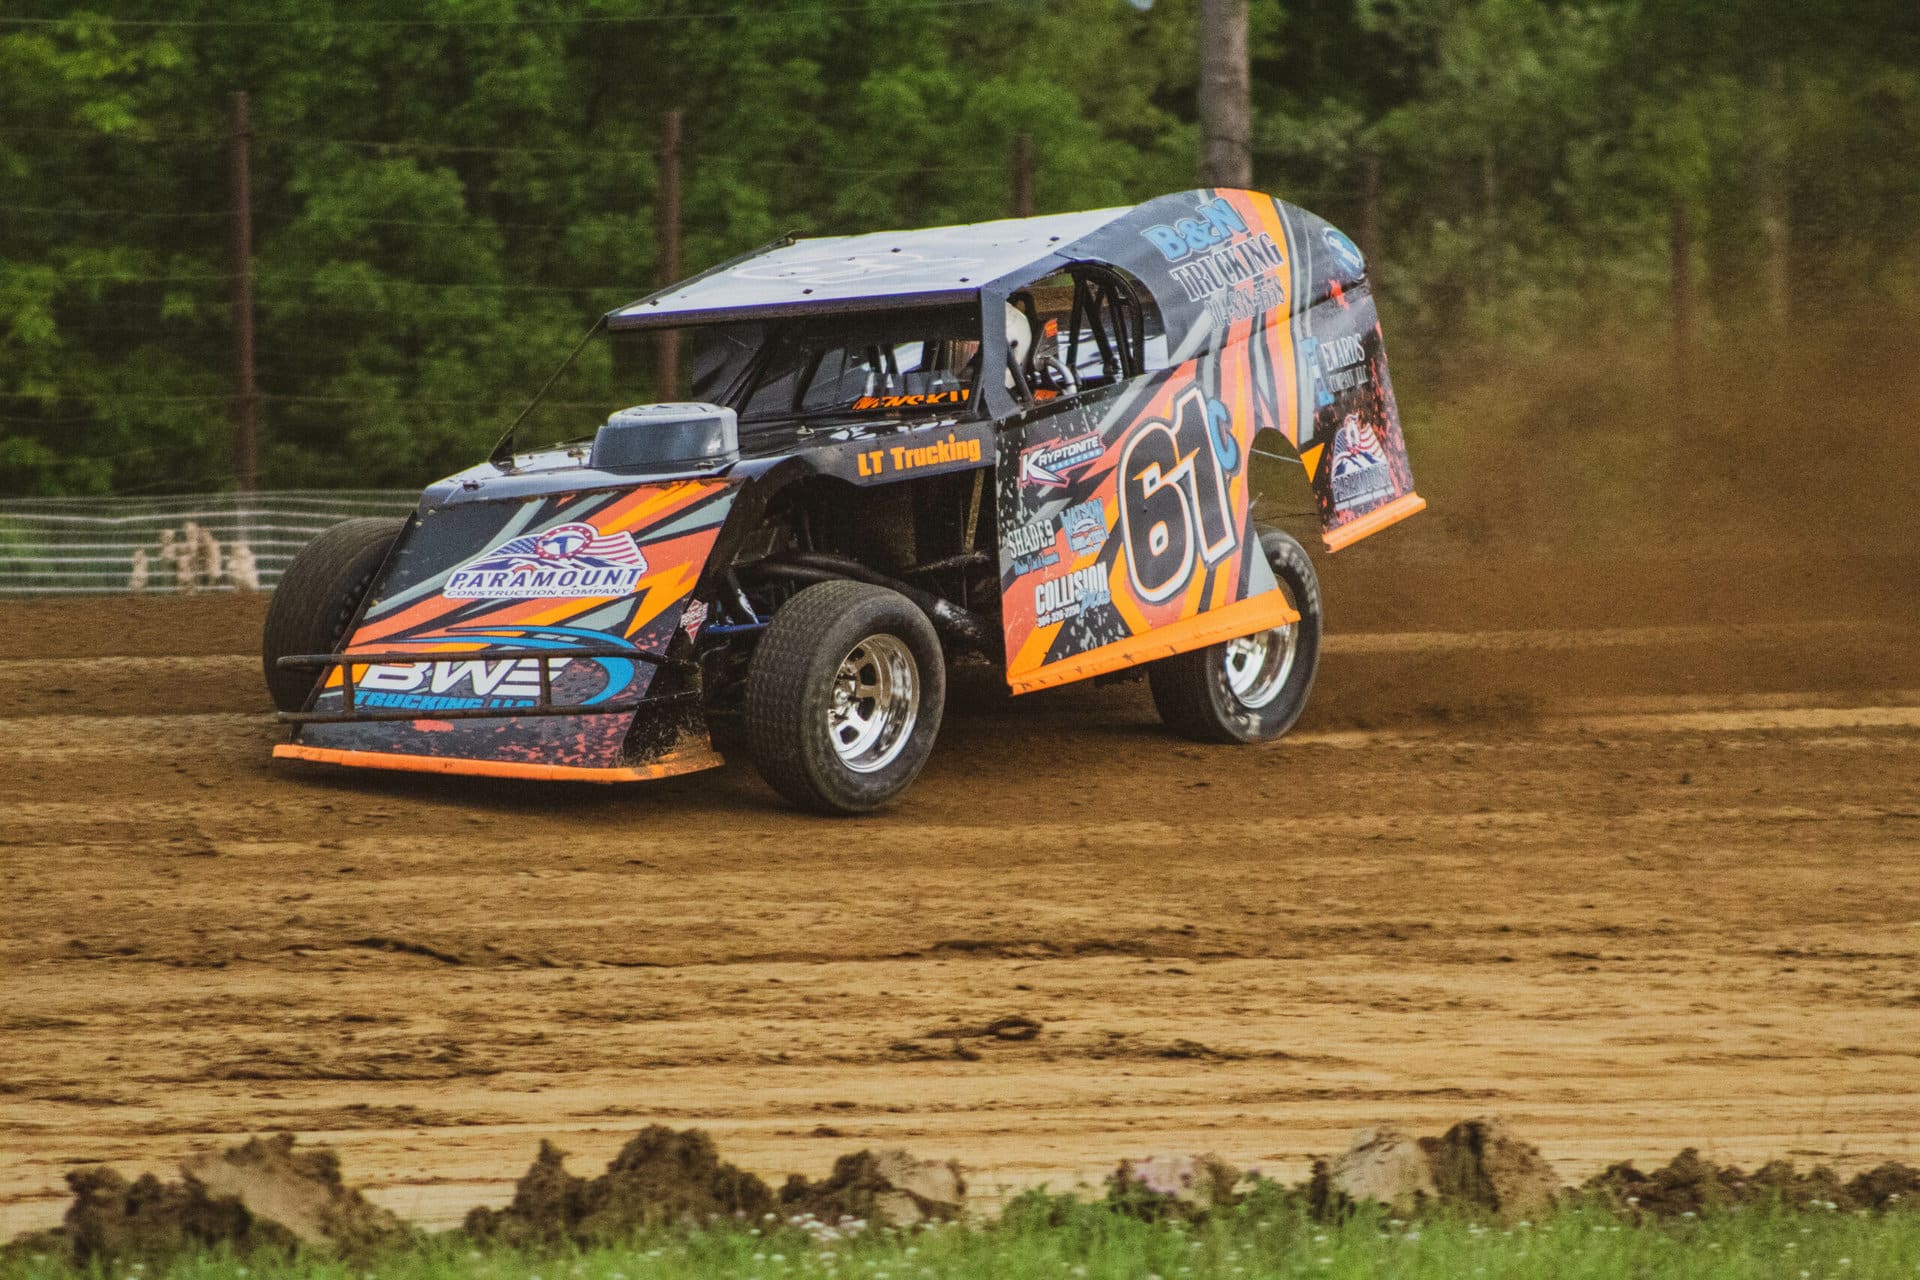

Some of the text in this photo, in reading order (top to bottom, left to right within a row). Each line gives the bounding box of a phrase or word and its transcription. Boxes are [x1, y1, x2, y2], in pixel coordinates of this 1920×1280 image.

[1141, 198, 1250, 262] B&N
[1170, 232, 1284, 302] TRUCKING
[857, 434, 981, 477] LT Trucking
[1022, 436, 1098, 482] KRYPTONITE
[1118, 383, 1237, 603] 61
[447, 587, 629, 597] CONSTRUCTION COMPANY
[449, 569, 642, 588] PARAMOUNT
[1035, 562, 1107, 615] COLLISION
[358, 658, 573, 697] BWE
